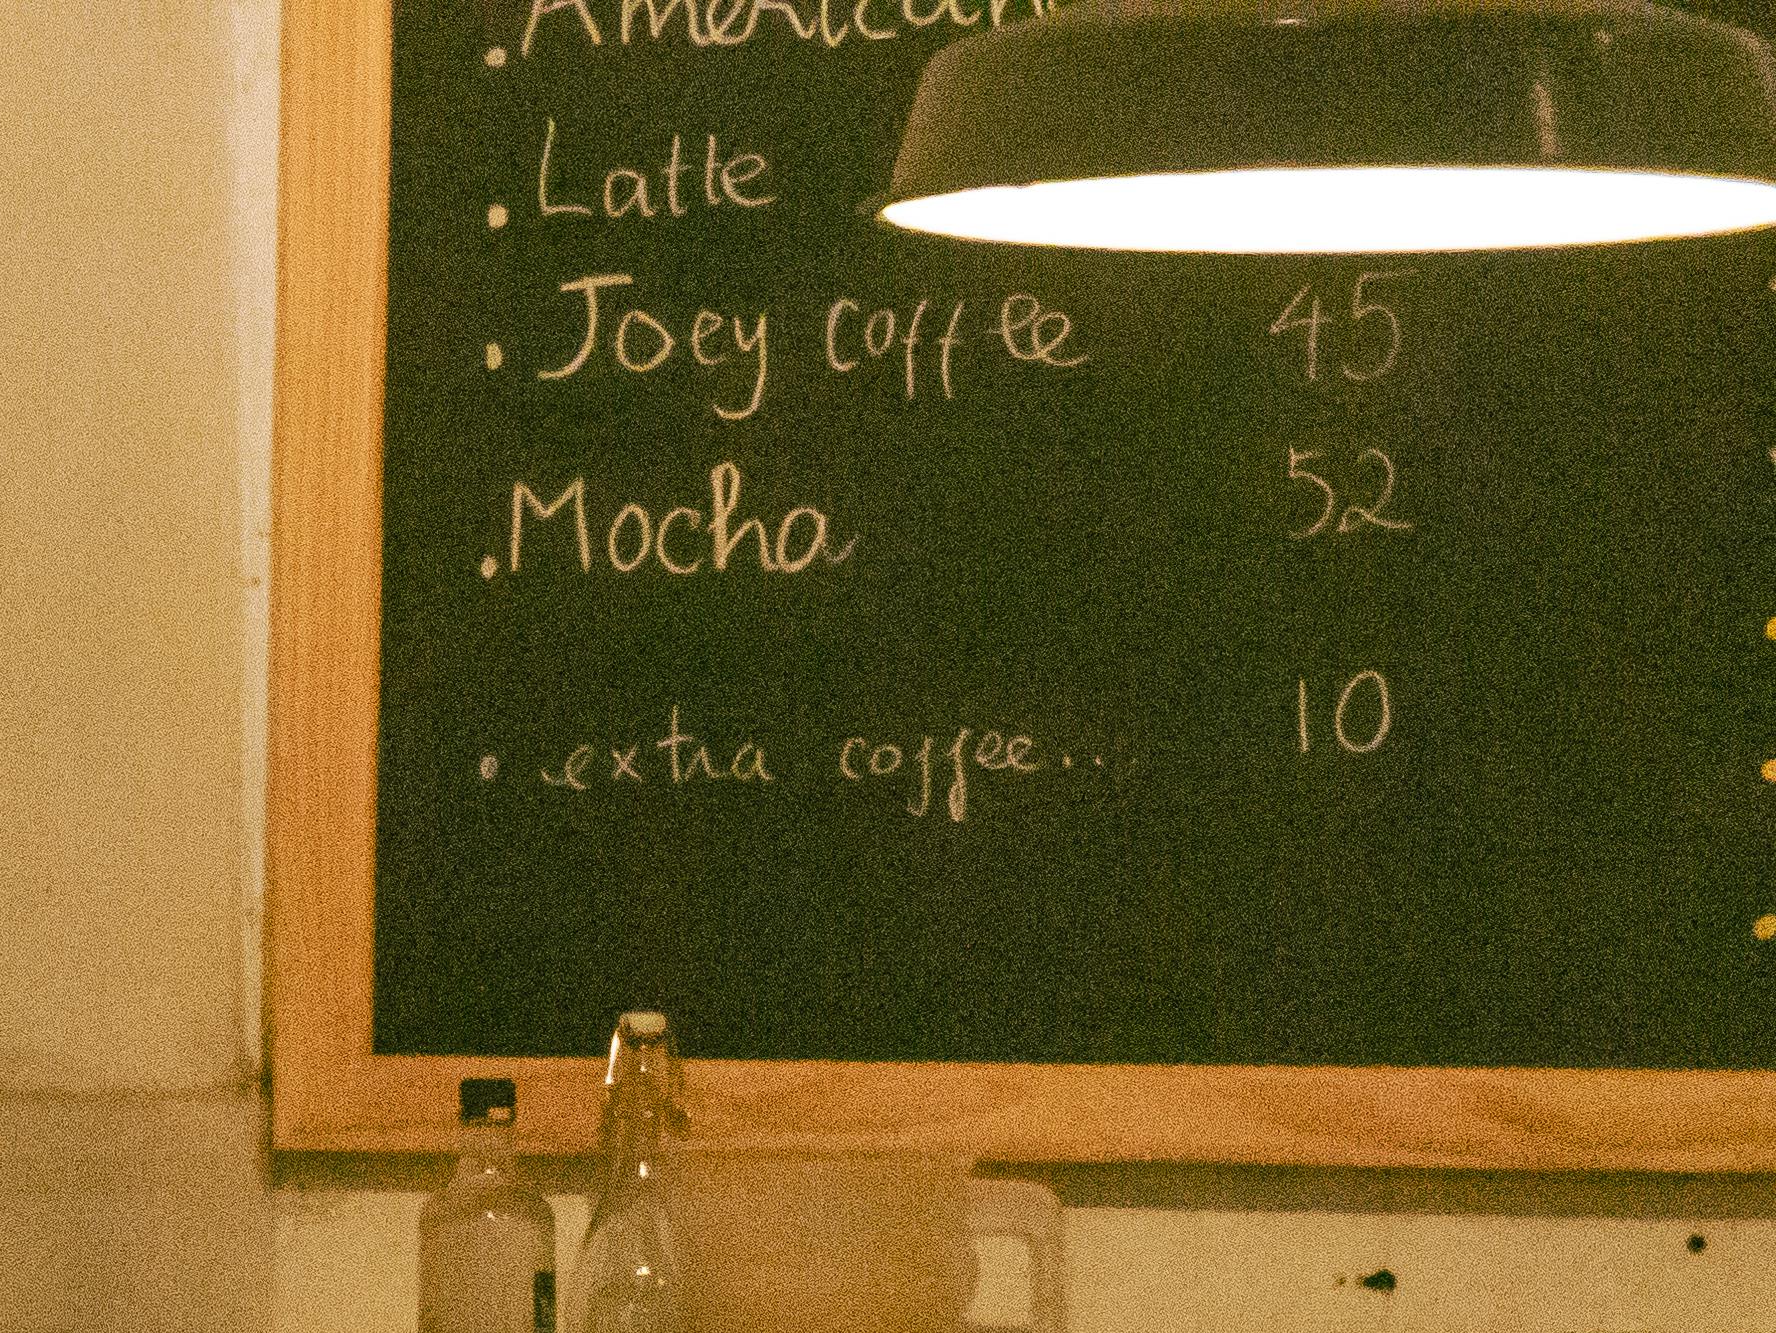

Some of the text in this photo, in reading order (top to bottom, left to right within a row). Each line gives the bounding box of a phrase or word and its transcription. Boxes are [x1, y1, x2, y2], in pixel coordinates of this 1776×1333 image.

[537, 117, 776, 219] Latte
[538, 270, 1412, 421] Joey coffee 45
[508, 445, 1412, 575] Mocha 52
[540, 706, 774, 792] extra
[1295, 669, 1393, 755] 10
